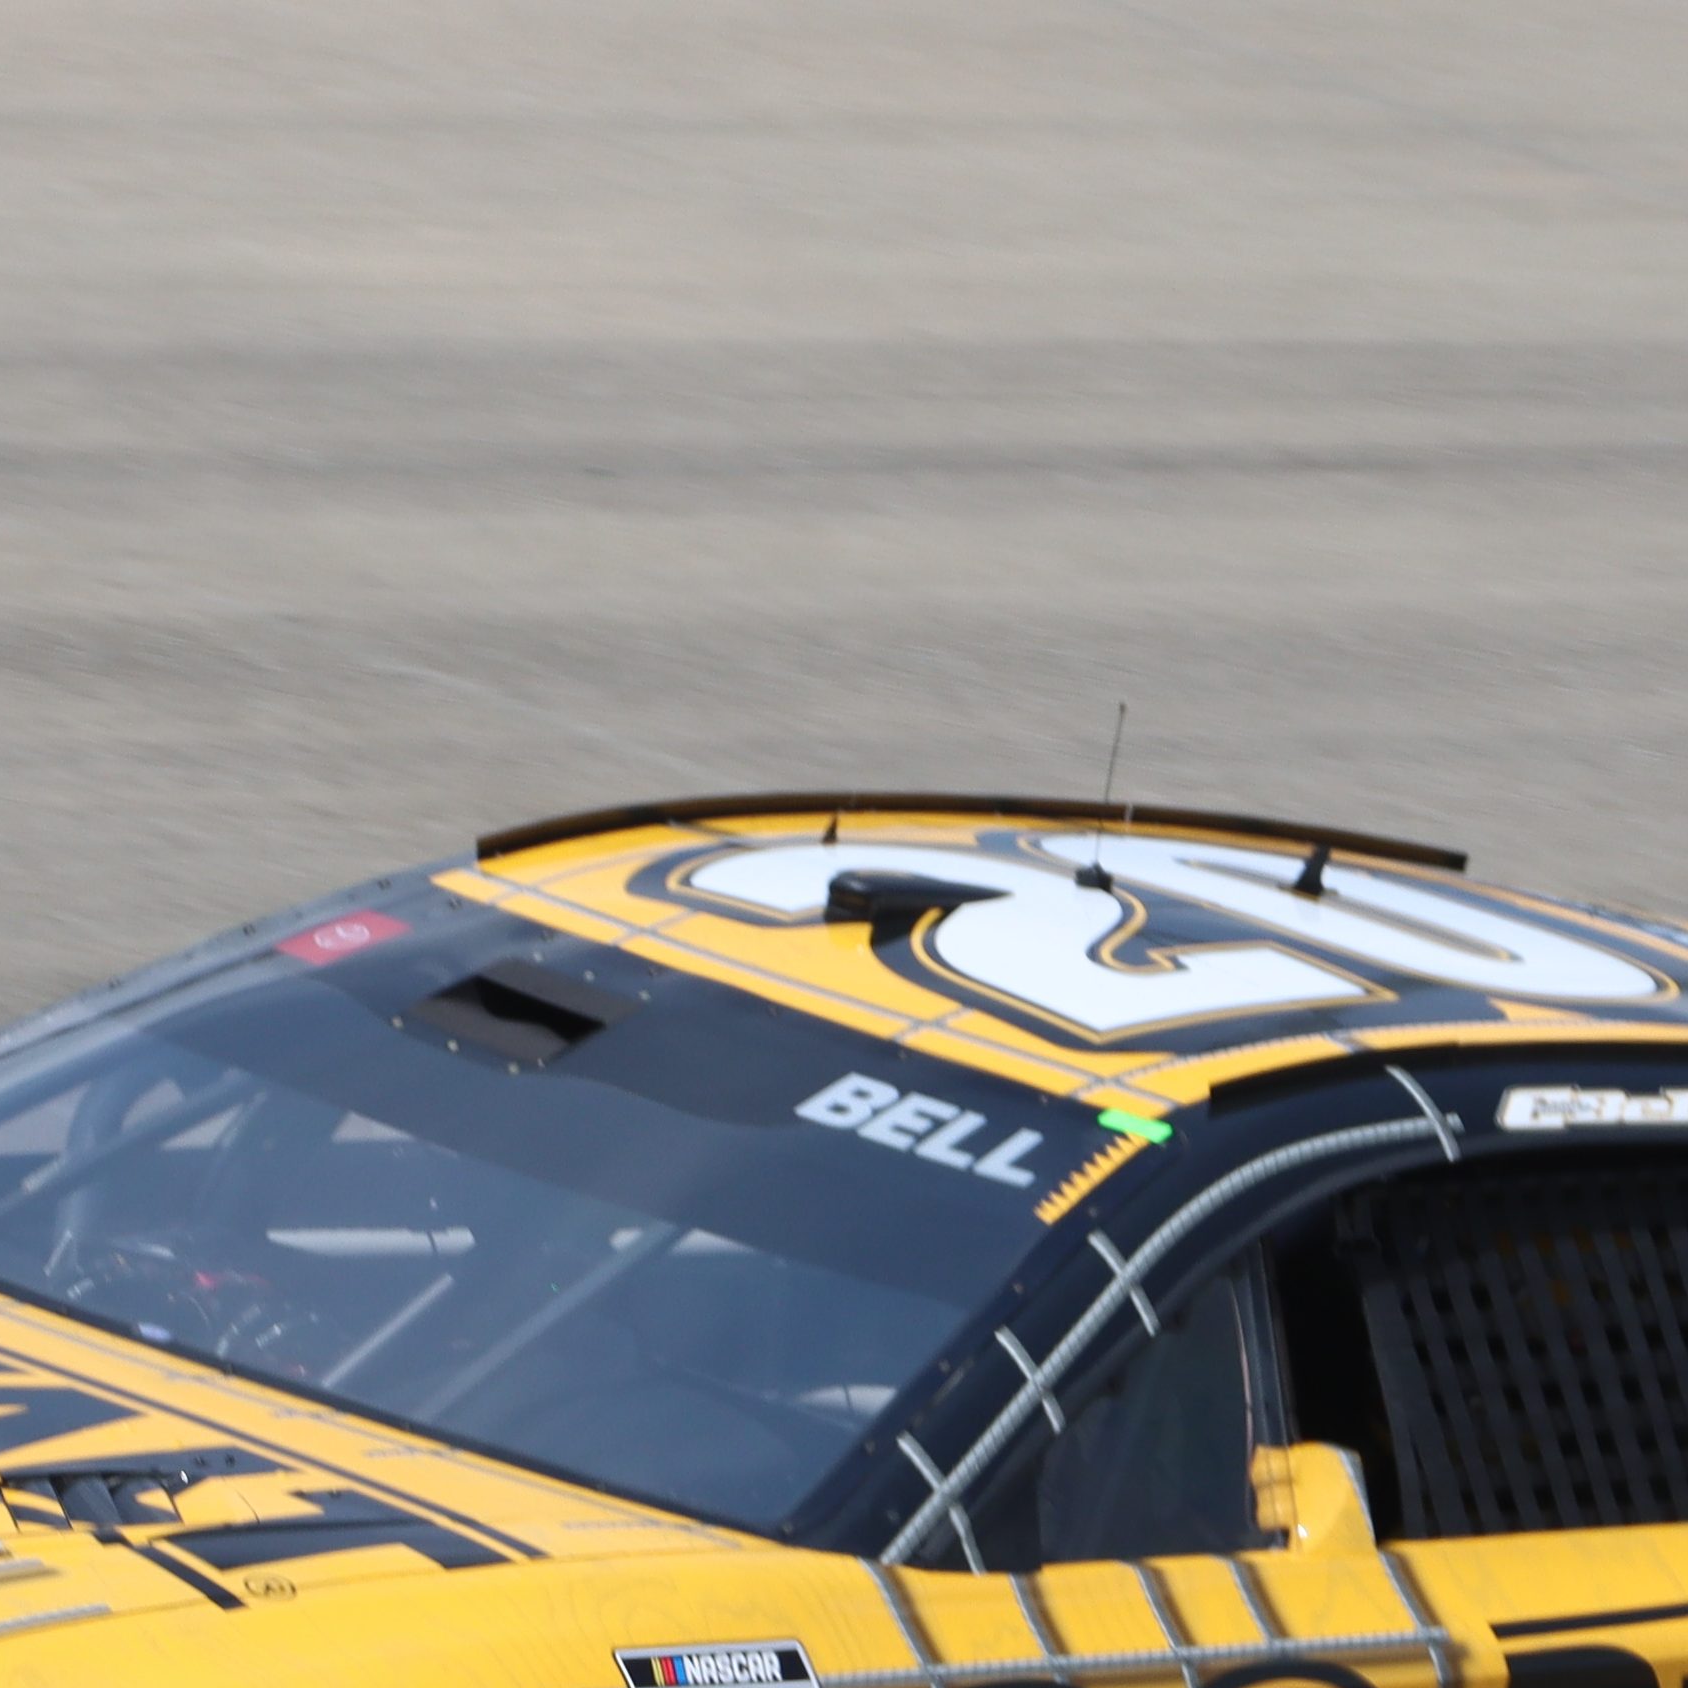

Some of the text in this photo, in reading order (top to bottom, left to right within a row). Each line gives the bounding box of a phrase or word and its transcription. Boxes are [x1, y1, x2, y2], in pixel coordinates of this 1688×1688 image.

[665, 830, 1679, 1046] 20
[795, 1070, 1047, 1190] BELL
[683, 1651, 783, 1686] NASCAR
